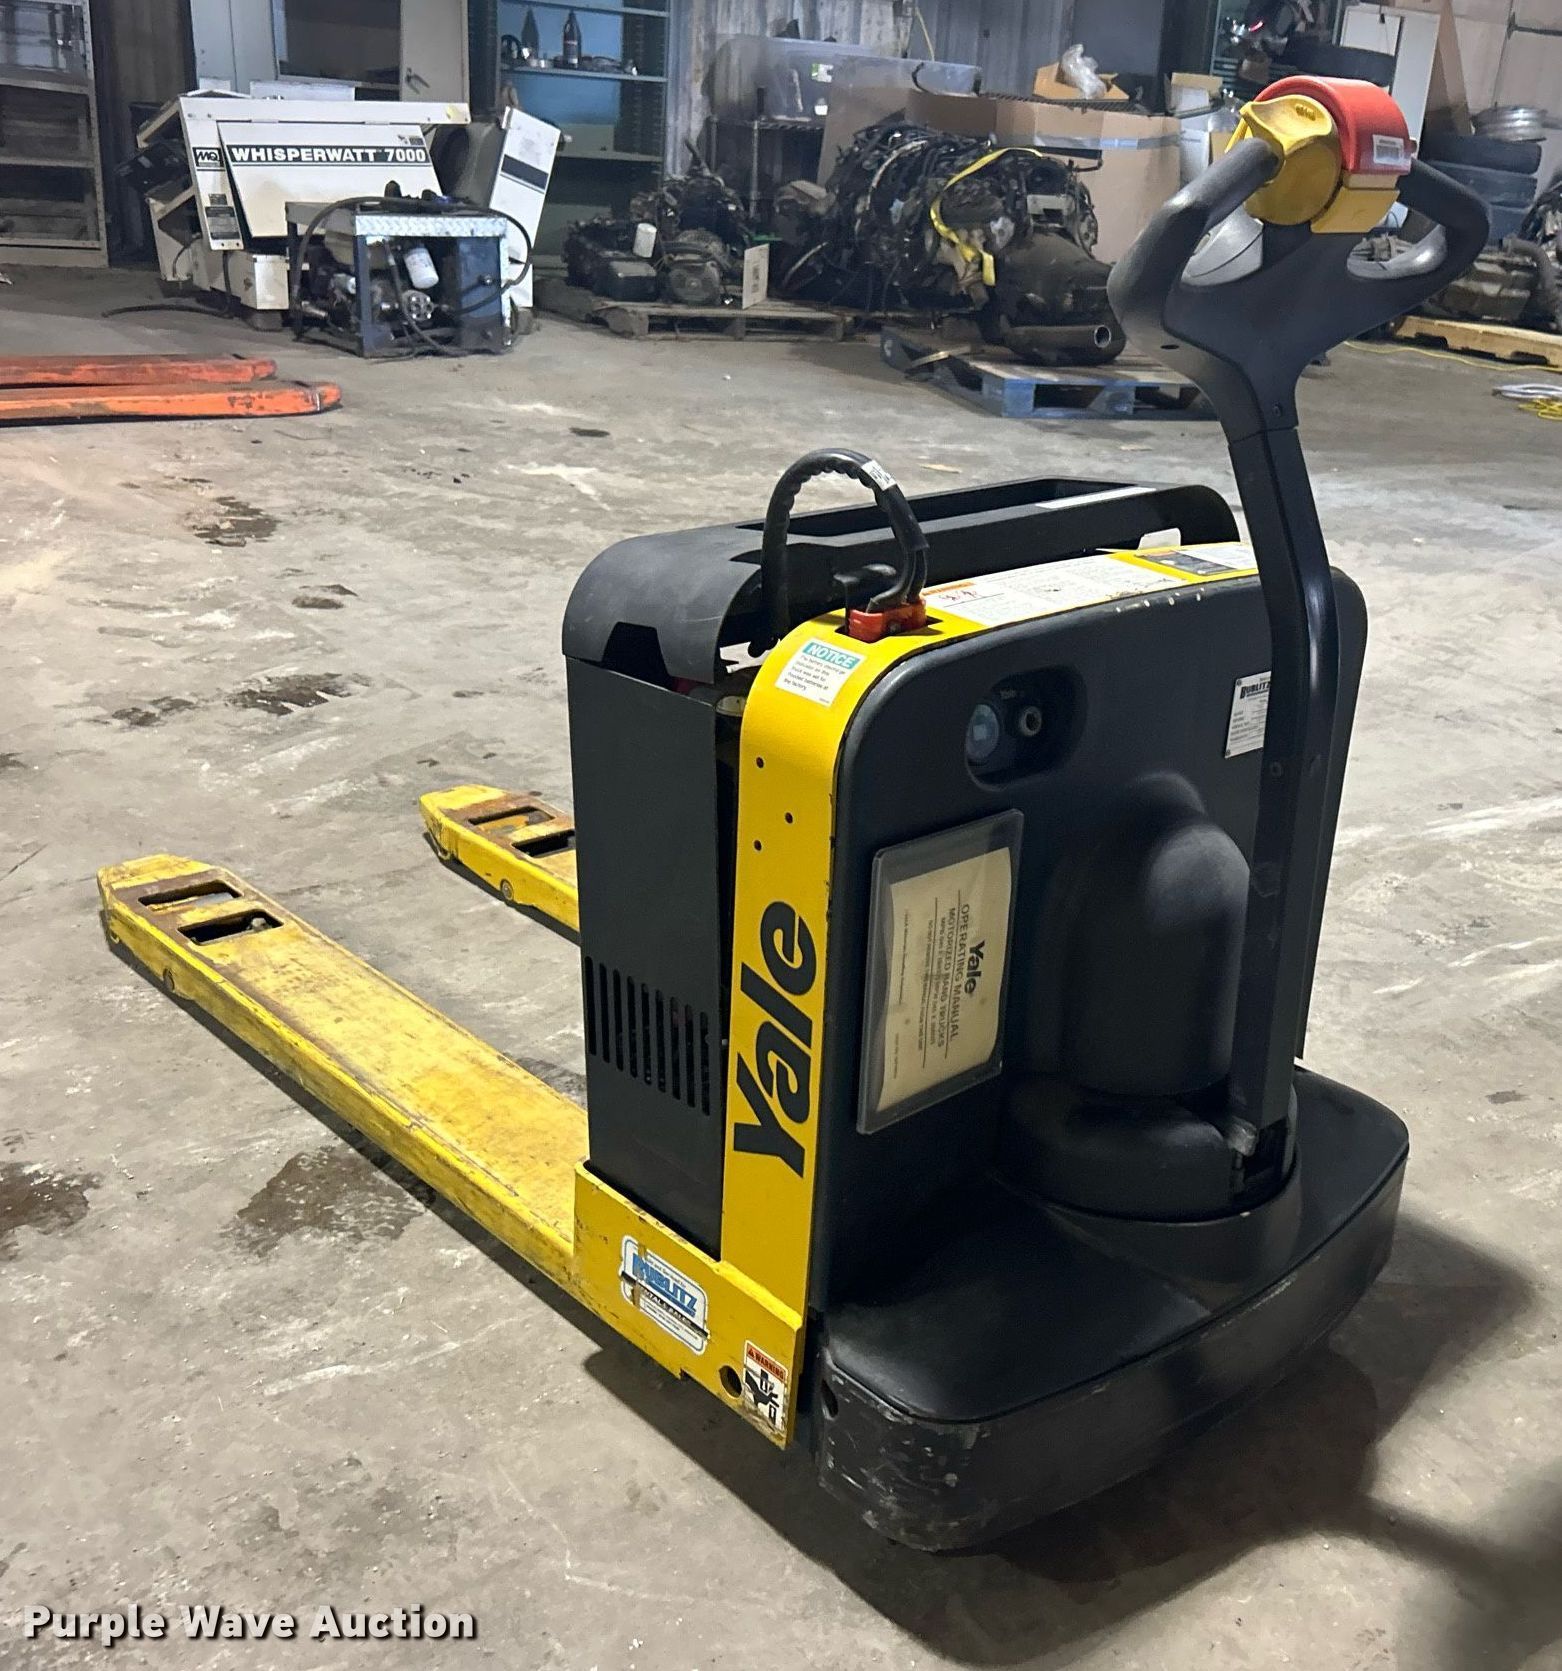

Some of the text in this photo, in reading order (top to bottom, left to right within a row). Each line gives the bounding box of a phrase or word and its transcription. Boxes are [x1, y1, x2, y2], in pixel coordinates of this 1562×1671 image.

[231, 147, 426, 162] WHISPERWATT 7000
[806, 643, 857, 669] NOTICE
[943, 907, 956, 971] MOTORIZED
[949, 903, 970, 1042] OPERATING MANUAL
[964, 939, 986, 995] Yale
[733, 901, 817, 1179] Yale
[937, 1005, 948, 1048] TRUCKS
[755, 1352, 784, 1380] WARNING
